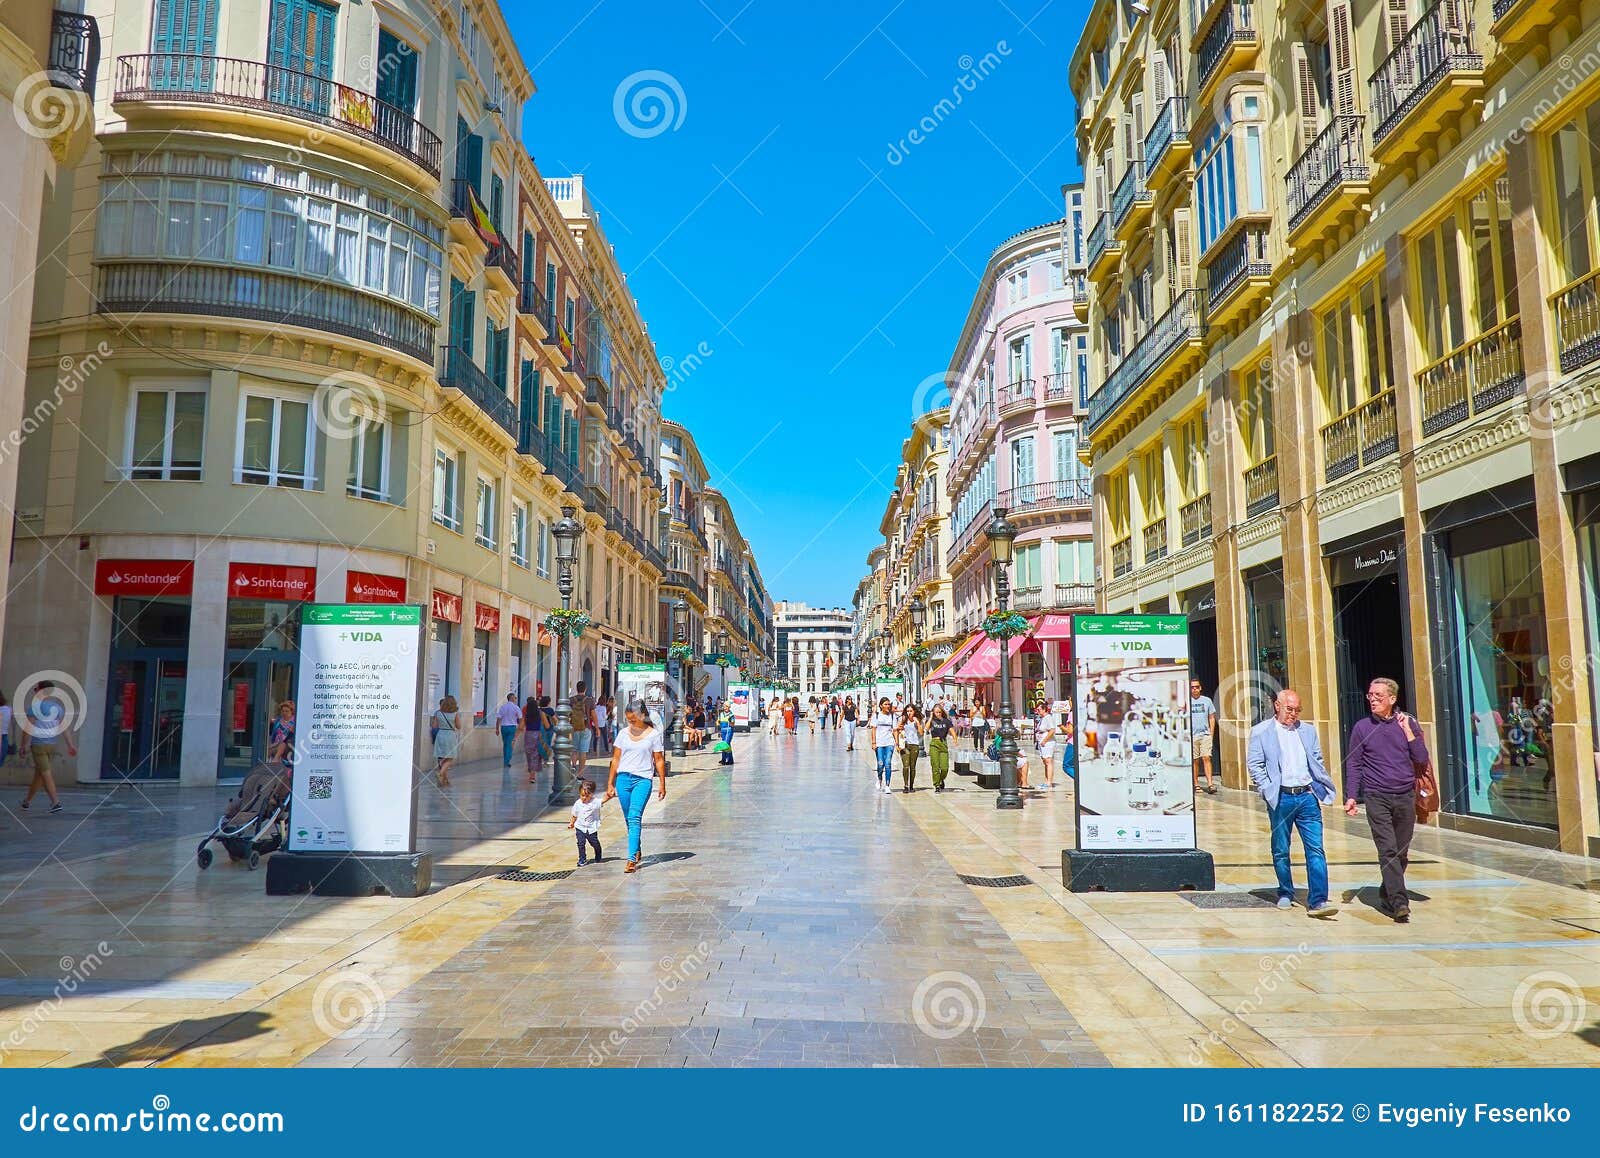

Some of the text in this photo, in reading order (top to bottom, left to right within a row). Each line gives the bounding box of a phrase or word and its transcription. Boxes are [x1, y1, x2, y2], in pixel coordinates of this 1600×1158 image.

[1355, 556, 1379, 570] Massimo
[123, 572, 181, 584] Santander
[251, 576, 308, 590] Santander
[363, 584, 399, 598] Santander
[351, 632, 383, 642] VIDA
[1121, 641, 1152, 651] VIDA
[315, 662, 329, 670] Con
[315, 672, 324, 680] de
[314, 683, 354, 691] conseguido
[314, 692, 352, 700] totalmente
[361, 692, 381, 700] mitad
[313, 702, 324, 710] los
[376, 703, 389, 711] tipo
[312, 712, 336, 720] cáncer
